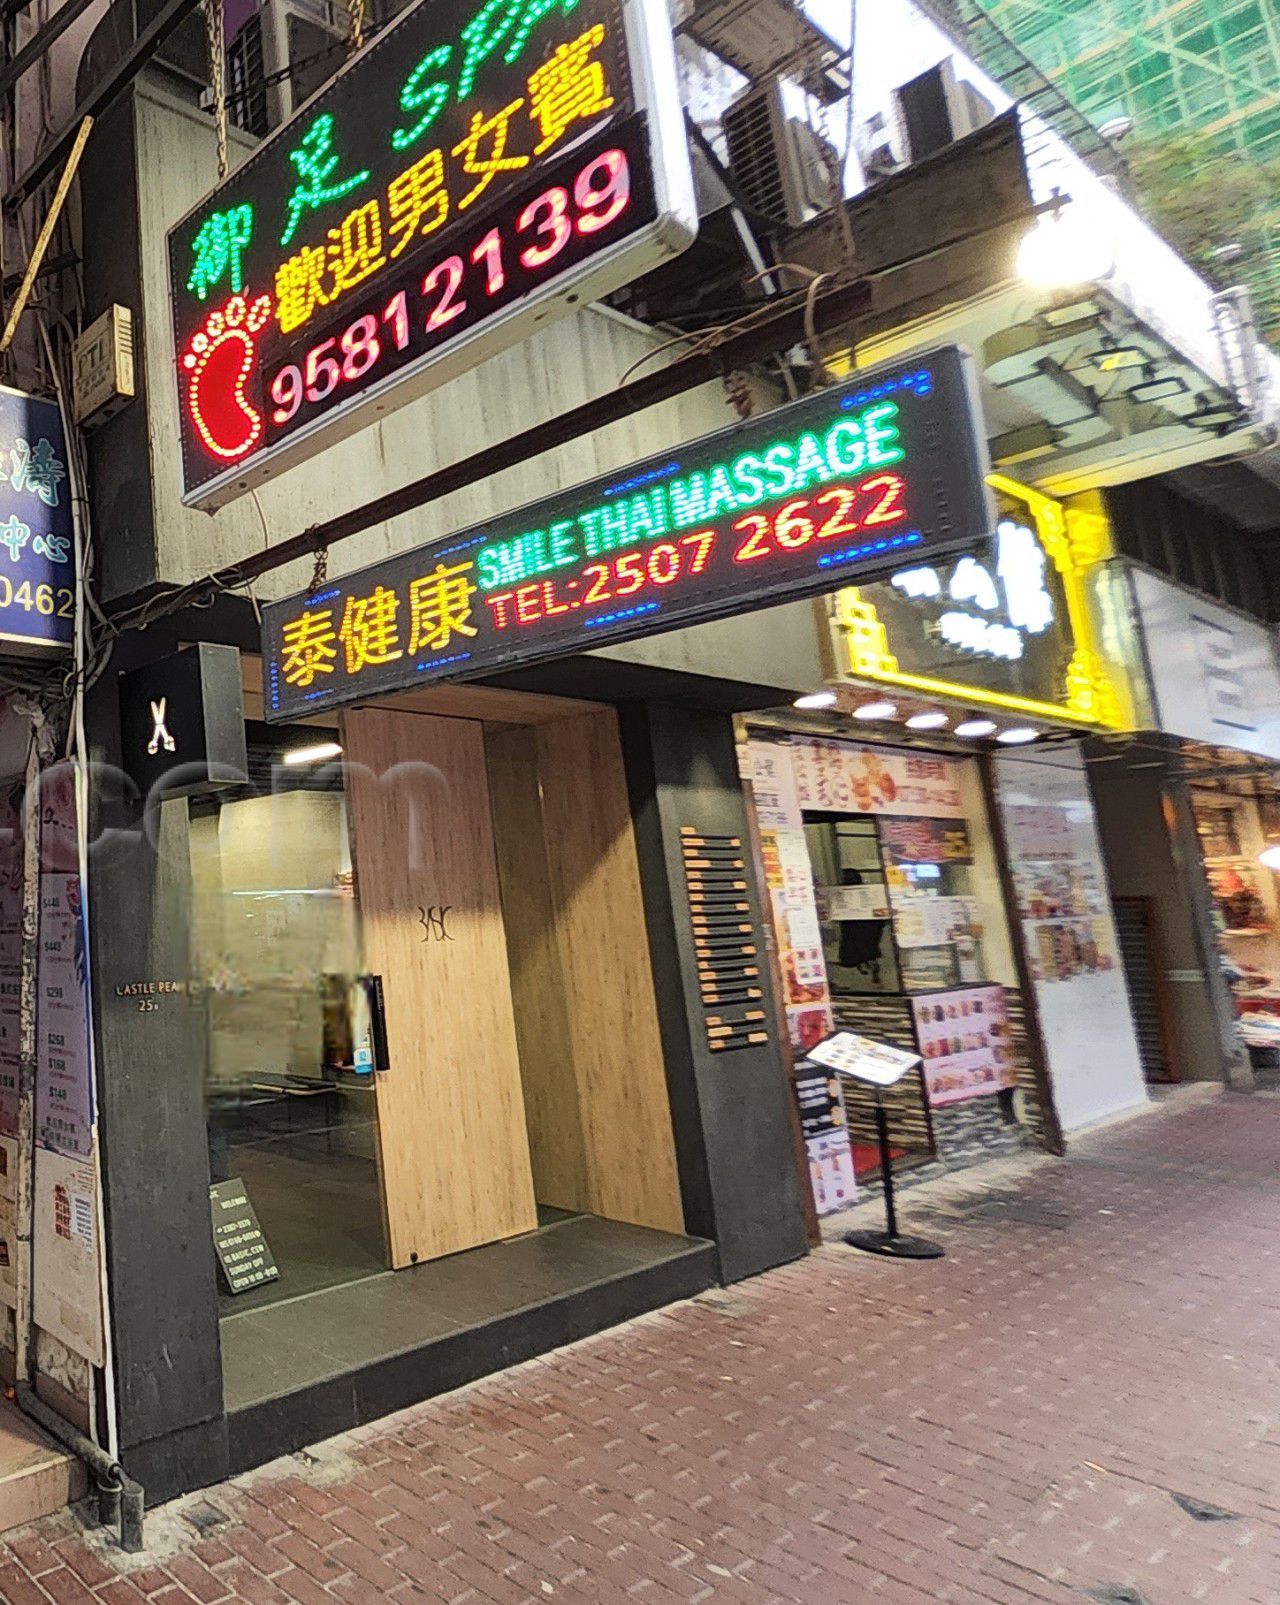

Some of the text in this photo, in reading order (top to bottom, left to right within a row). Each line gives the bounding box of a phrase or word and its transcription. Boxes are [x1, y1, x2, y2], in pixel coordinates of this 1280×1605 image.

[274, 23, 615, 335] 歡迎男女賓
[477, 401, 906, 591] SMILE THAI MASSAGE
[732, 472, 906, 564] 2622
[281, 560, 478, 687] 泰健康
